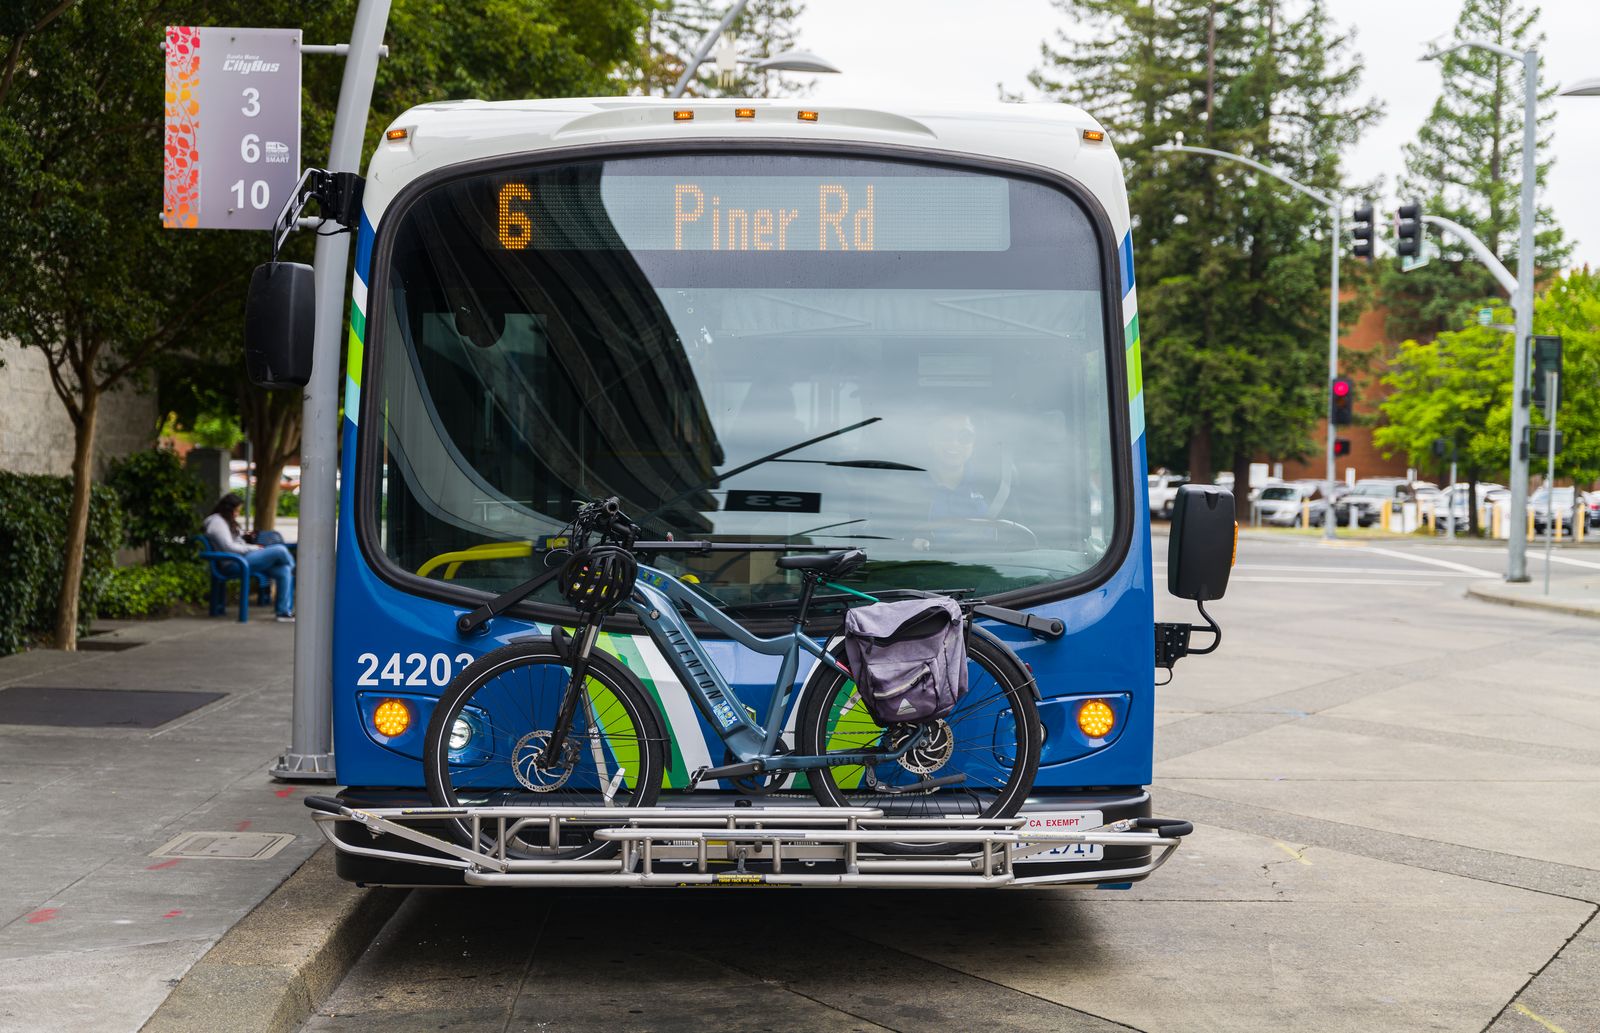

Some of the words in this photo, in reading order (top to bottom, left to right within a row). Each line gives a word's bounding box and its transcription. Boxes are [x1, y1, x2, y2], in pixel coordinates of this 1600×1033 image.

[223, 60, 280, 74] CityBus
[241, 87, 261, 117] 3
[241, 134, 260, 163] 6
[231, 180, 270, 209] 10
[499, 183, 531, 250] 6
[674, 184, 798, 250] Piner
[819, 184, 874, 250] Rd
[667, 630, 723, 699] AVENTON
[1046, 819, 1080, 827] EXEMPT
